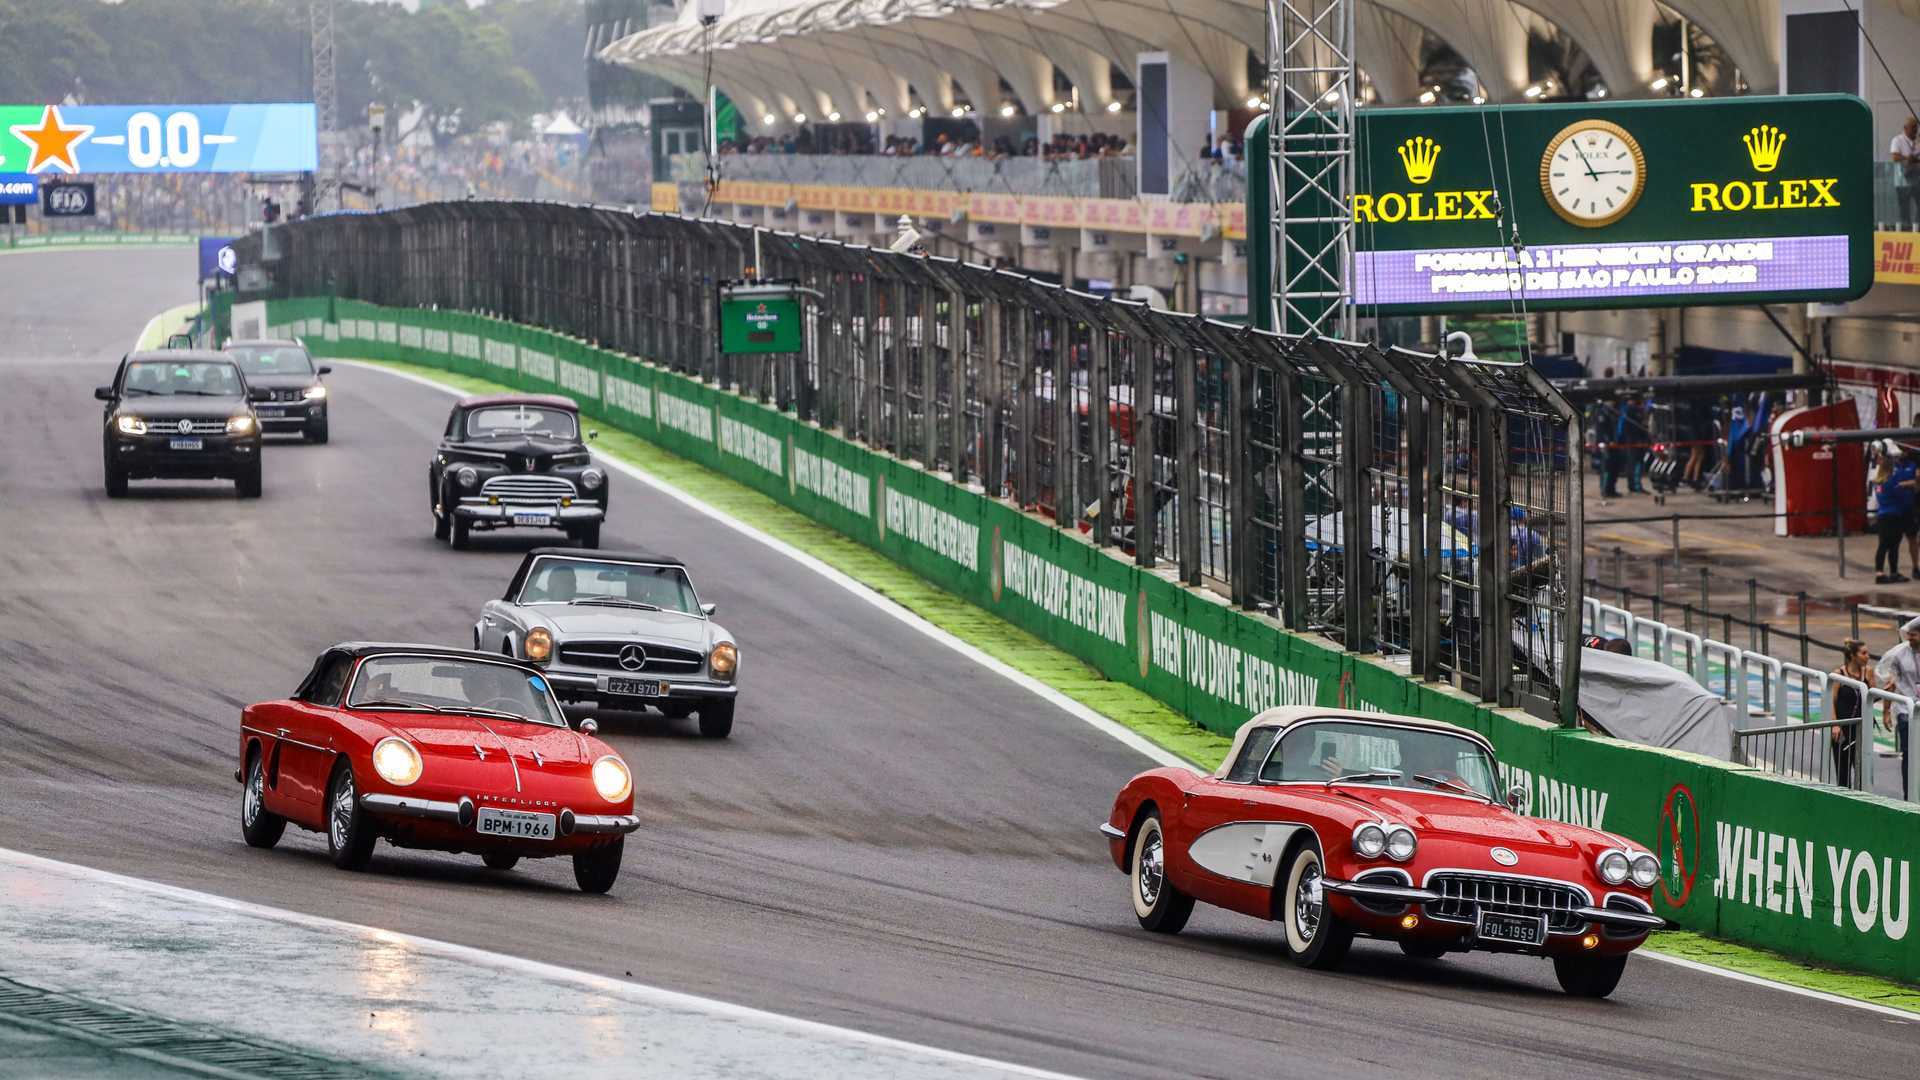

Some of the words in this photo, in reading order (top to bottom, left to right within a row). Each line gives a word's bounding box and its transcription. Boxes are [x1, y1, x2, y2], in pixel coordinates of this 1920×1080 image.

[0, 182, 34, 194] .com
[52, 191, 84, 209] FIA
[1690, 178, 1841, 212] ROLEX
[1346, 190, 1496, 223] ROLEX
[1415, 250, 1535, 272] FORMULA
[1672, 241, 1773, 264] GRANDE
[1882, 240, 1914, 273] DHL
[1525, 270, 1559, 290] DE
[1612, 266, 1695, 288] PAULO
[1696, 264, 1757, 285] 2022
[1003, 540, 1026, 597] WHEN
[1026, 549, 1043, 607] YOU
[1044, 560, 1069, 620] DRIVE
[1069, 573, 1098, 633] NEVER
[1098, 585, 1127, 647] DRINK
[1151, 610, 1182, 678] WHEN
[1184, 627, 1206, 691] YOU
[1208, 638, 1241, 705] DRIVE
[1244, 652, 1276, 714] NEVER
[1539, 774, 1609, 831] DRINK
[1714, 821, 1814, 919] WHEN
[1826, 845, 1910, 941] YOU
